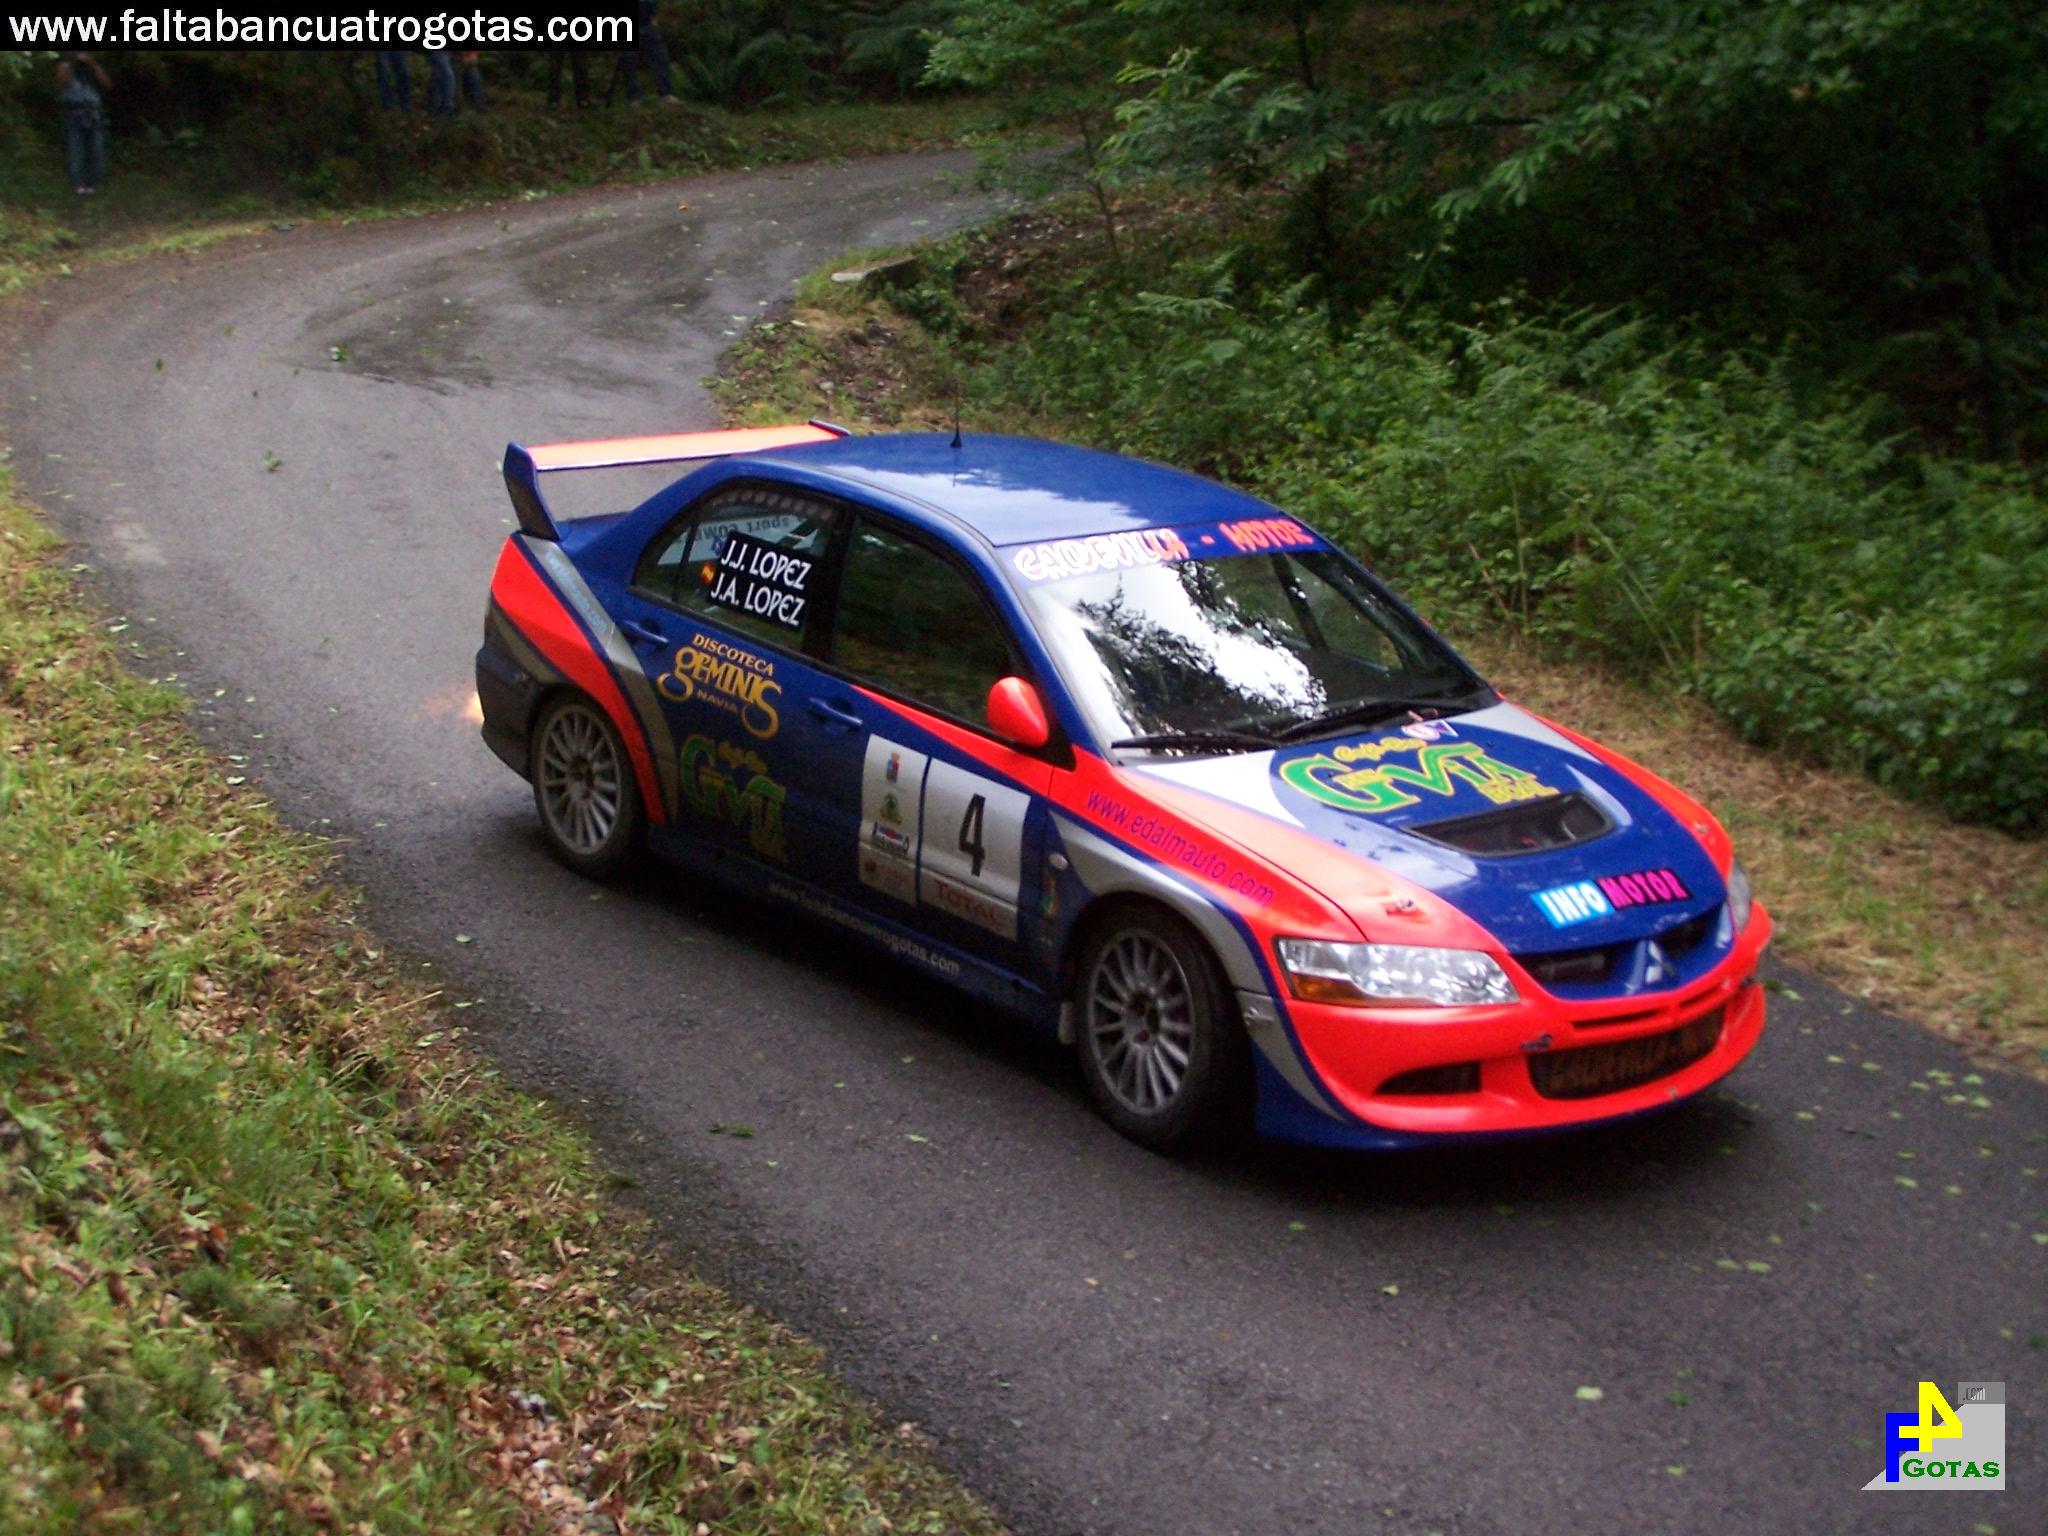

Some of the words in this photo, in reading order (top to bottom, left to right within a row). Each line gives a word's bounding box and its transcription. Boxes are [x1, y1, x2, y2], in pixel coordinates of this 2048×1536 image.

[720, 540, 748, 572] J.J.
[749, 548, 812, 590] LOPEZ
[710, 572, 740, 606] J.A.
[743, 582, 806, 626] LOPEZ
[692, 633, 776, 678] DISCOTECA
[958, 792, 986, 877] 4
